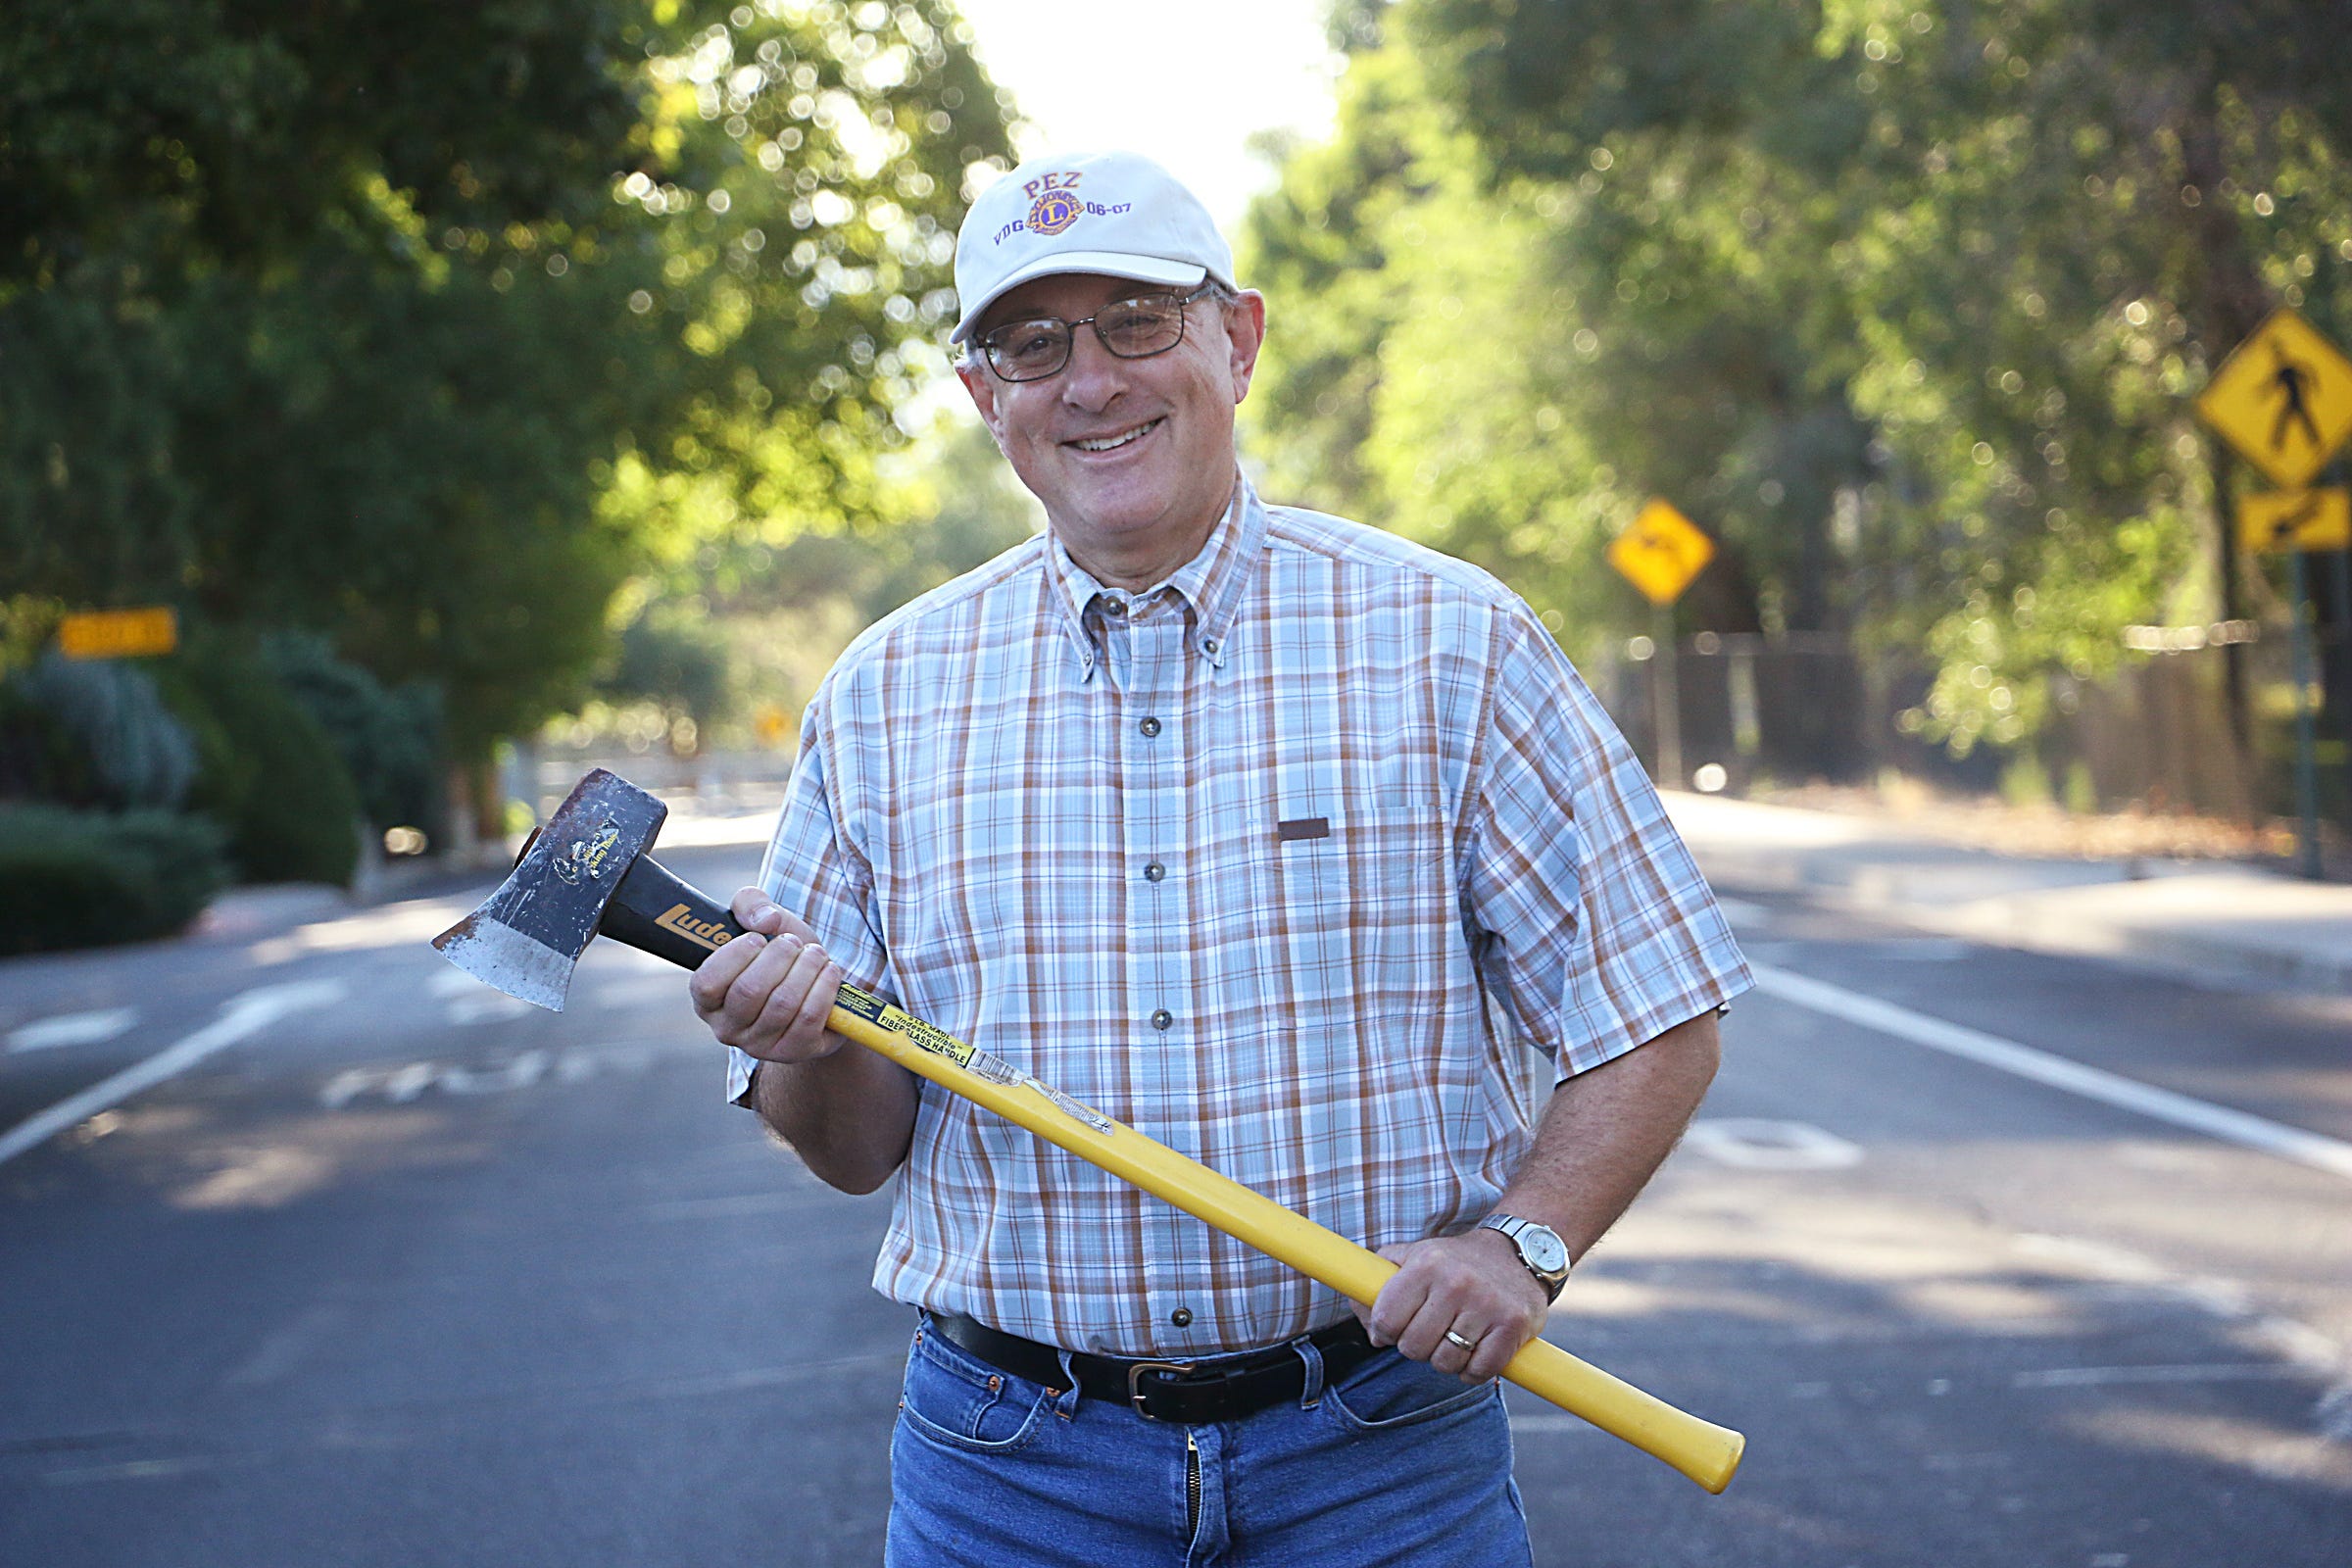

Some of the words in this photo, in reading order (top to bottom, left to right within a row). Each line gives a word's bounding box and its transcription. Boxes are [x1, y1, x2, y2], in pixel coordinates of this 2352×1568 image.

[1022, 172, 1083, 200] PEZ
[993, 219, 1024, 246] VDG
[1086, 201, 1132, 216] 06-07
[1047, 204, 1065, 224] L
[654, 903, 733, 952] Lude
